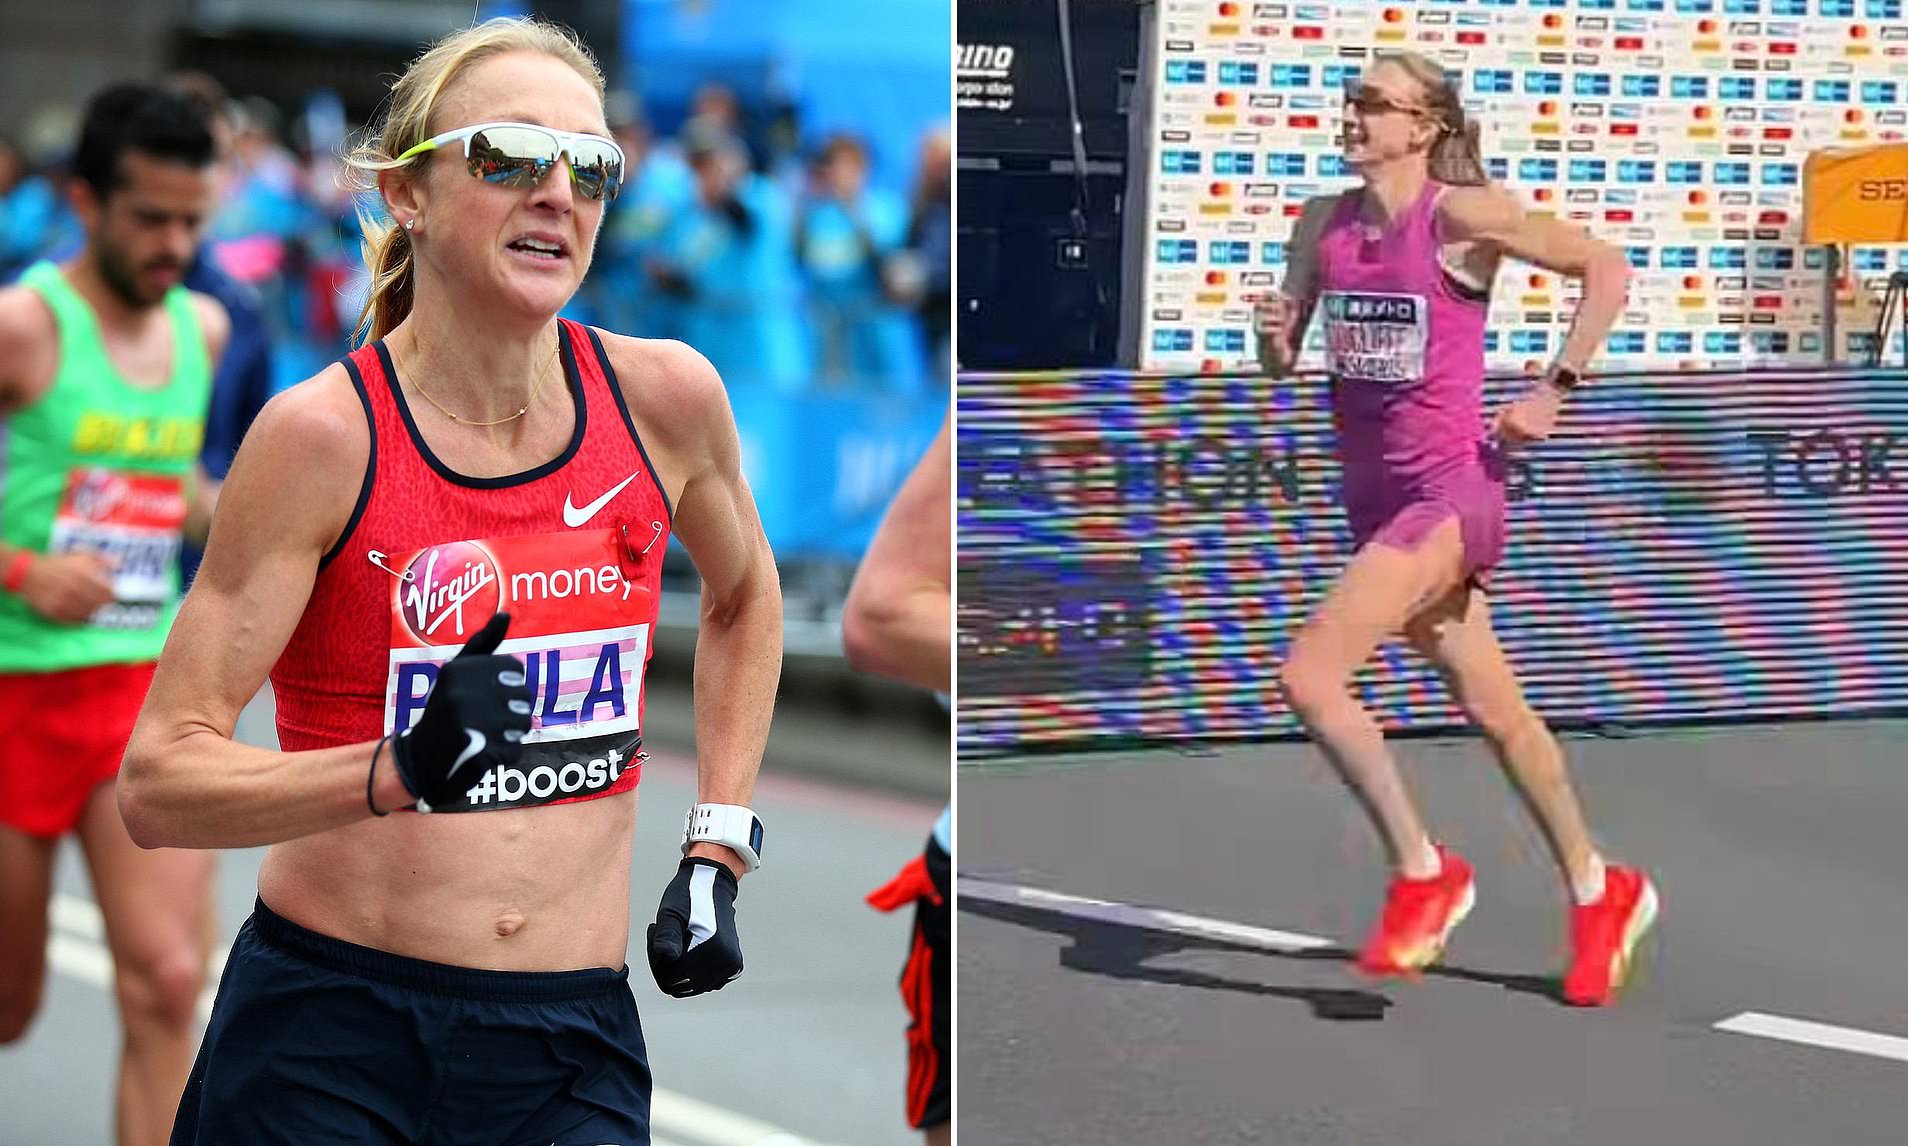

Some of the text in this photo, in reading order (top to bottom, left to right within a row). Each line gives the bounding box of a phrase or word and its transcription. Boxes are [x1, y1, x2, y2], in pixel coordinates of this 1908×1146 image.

[406, 549, 632, 636] Virgin money
[394, 642, 626, 738] PLA
[466, 749, 624, 805] #boost
